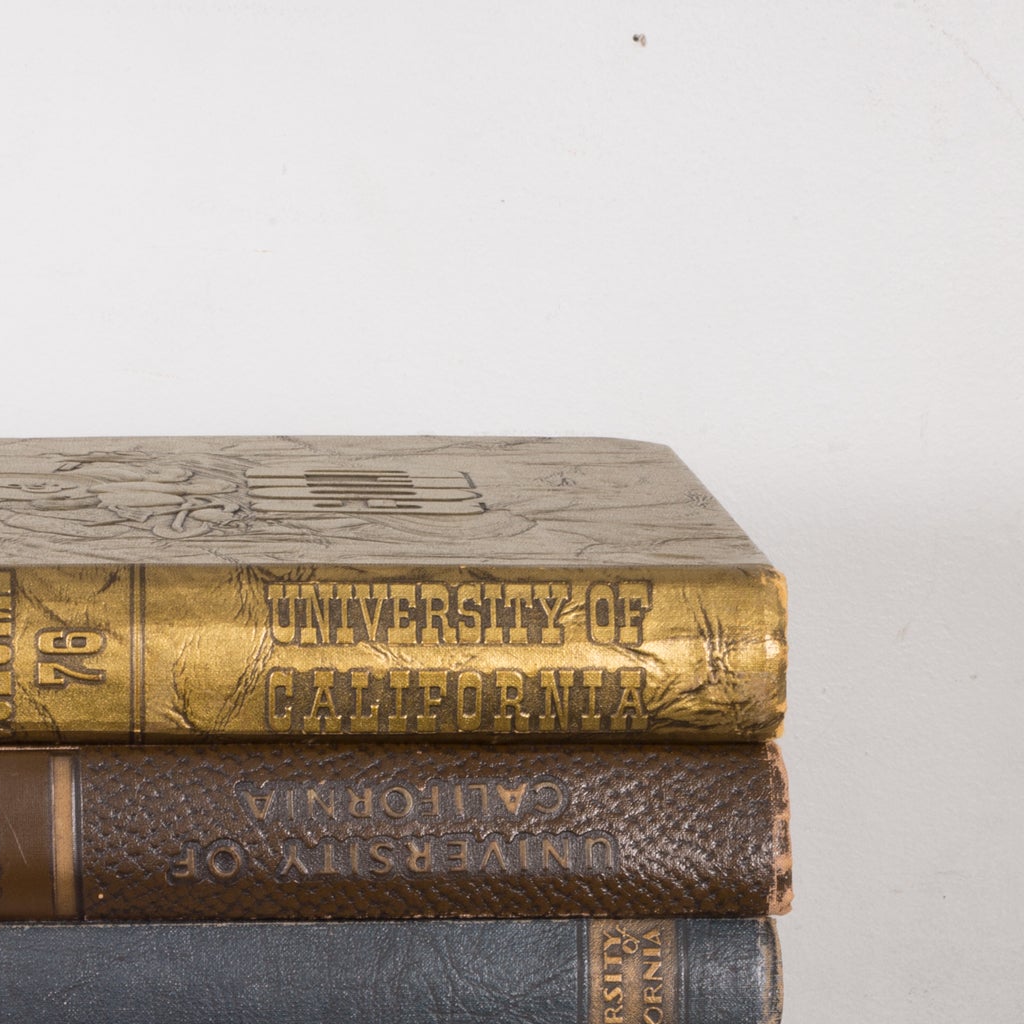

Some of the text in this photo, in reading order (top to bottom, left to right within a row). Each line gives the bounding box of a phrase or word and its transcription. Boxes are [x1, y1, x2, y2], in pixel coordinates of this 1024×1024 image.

[270, 580, 652, 645] UNIVERSITY OF
[37, 630, 103, 685] 76
[267, 667, 649, 734] CALIFORNIA
[247, 777, 571, 820] CALIFORNIA
[173, 832, 616, 883] UNIVERSITY OF
[615, 924, 641, 954] of
